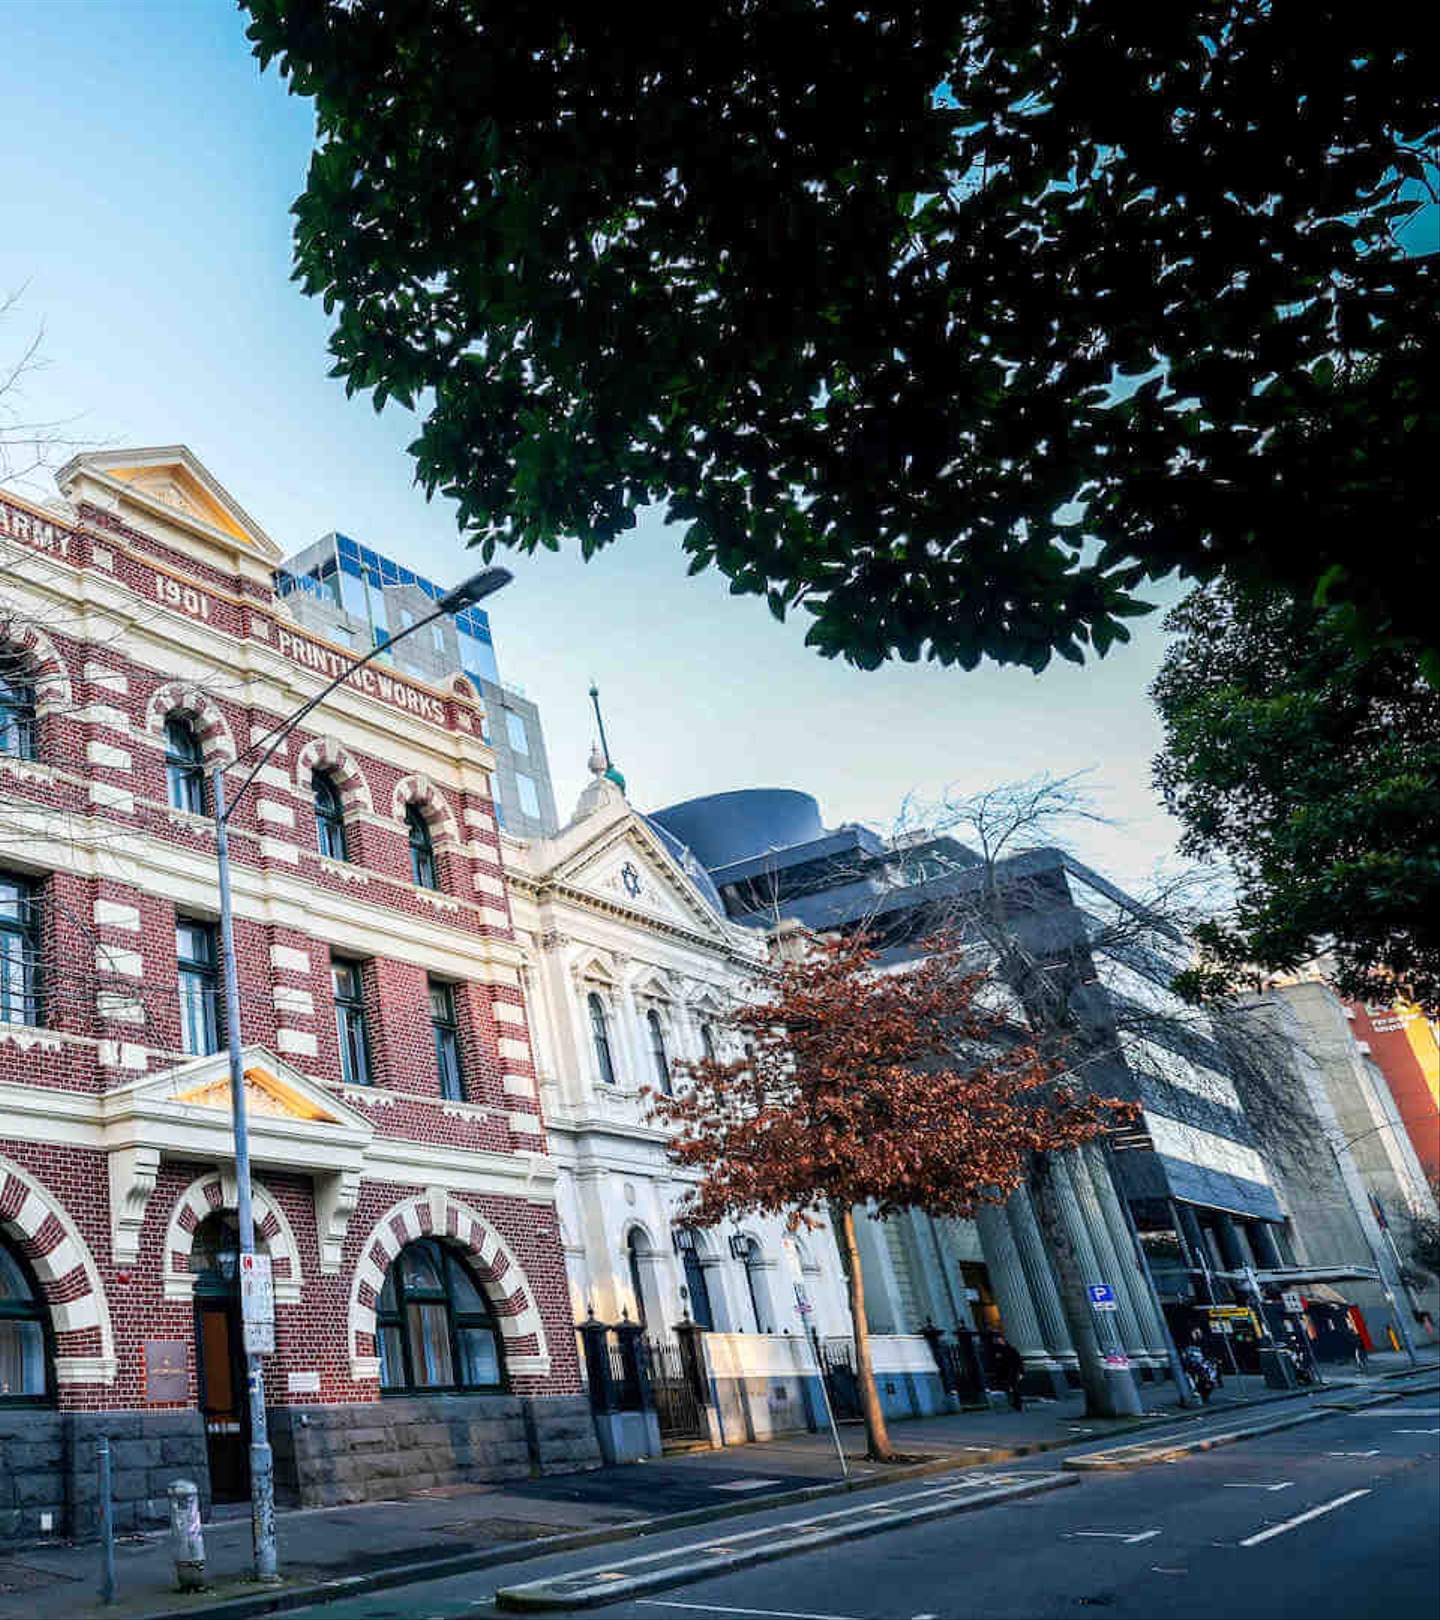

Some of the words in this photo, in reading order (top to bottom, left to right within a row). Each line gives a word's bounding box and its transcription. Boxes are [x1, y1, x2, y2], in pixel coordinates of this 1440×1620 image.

[156, 575, 208, 619] 1901
[377, 671, 446, 724] WORKS
[1093, 1287, 1106, 1300] P
